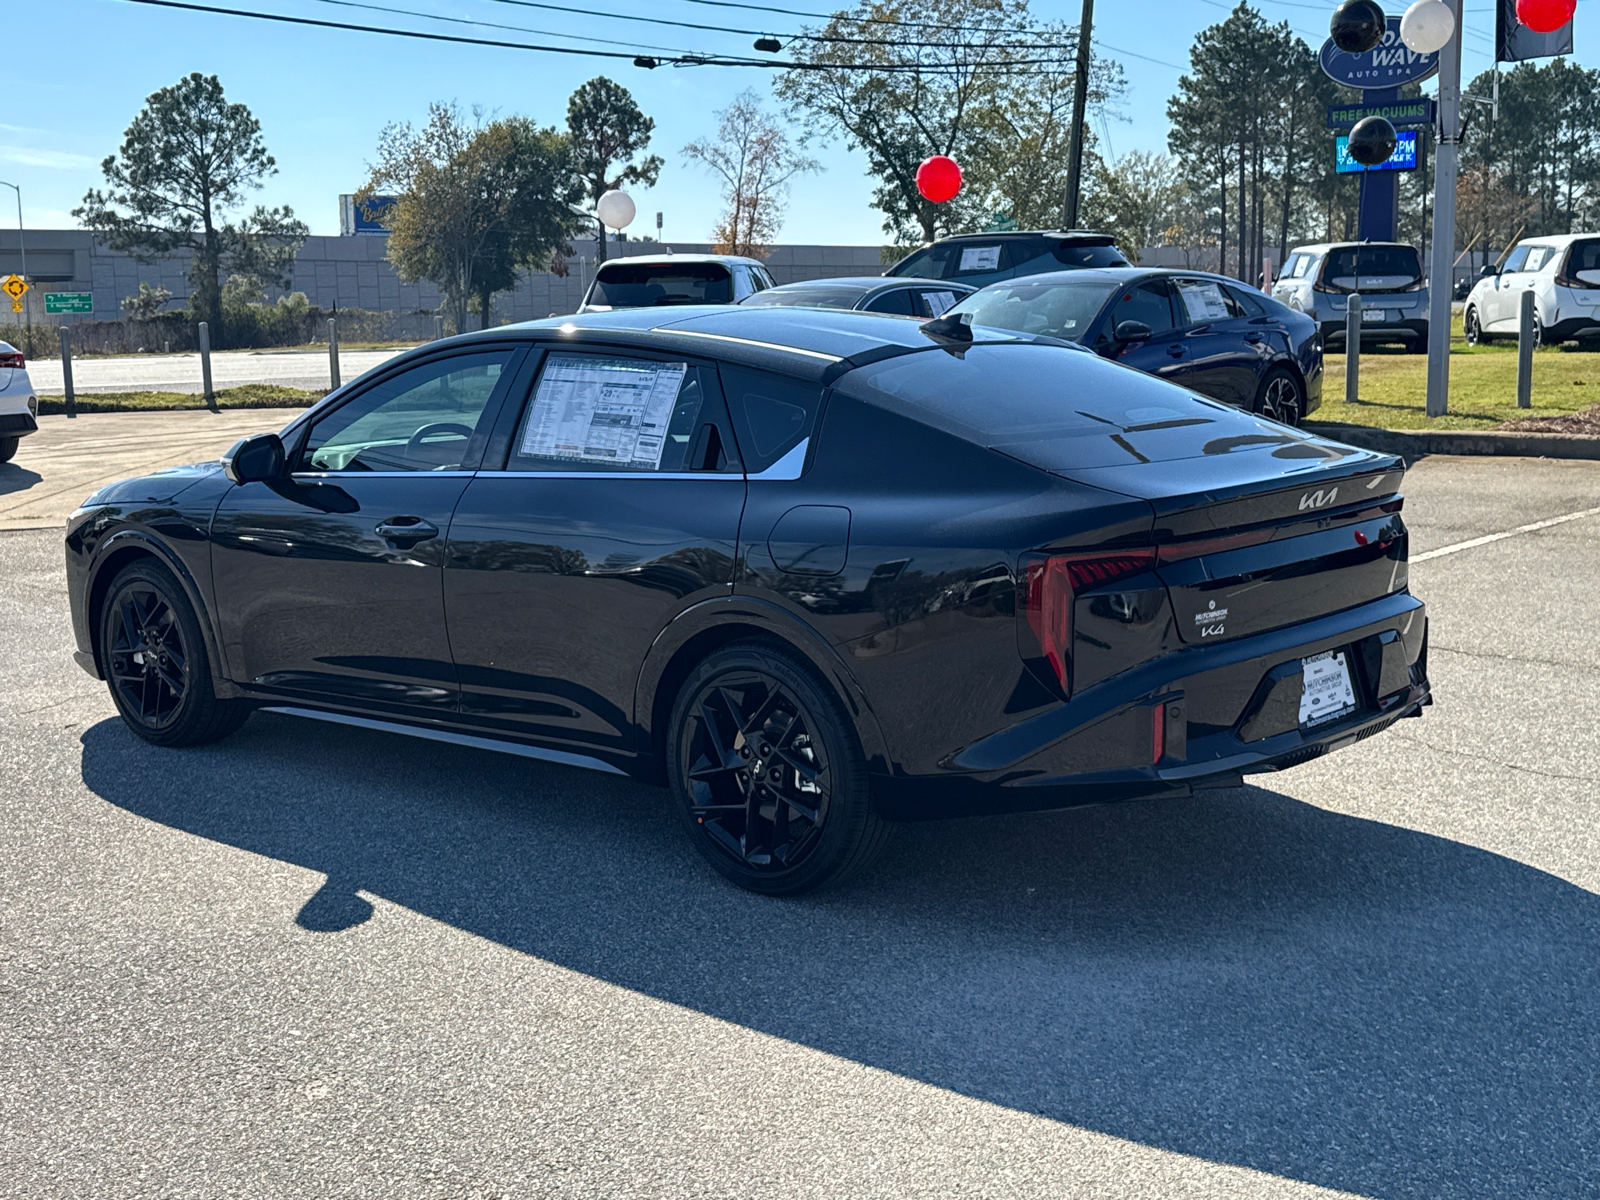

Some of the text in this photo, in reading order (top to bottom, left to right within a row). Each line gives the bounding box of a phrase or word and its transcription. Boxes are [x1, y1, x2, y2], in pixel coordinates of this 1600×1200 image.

[1372, 48, 1431, 67] WAVE
[1348, 67, 1411, 79] AUTO SPA
[1332, 104, 1425, 123] FREE VACUUMS
[1298, 487, 1339, 511] KIA
[1201, 623, 1225, 637] K4
